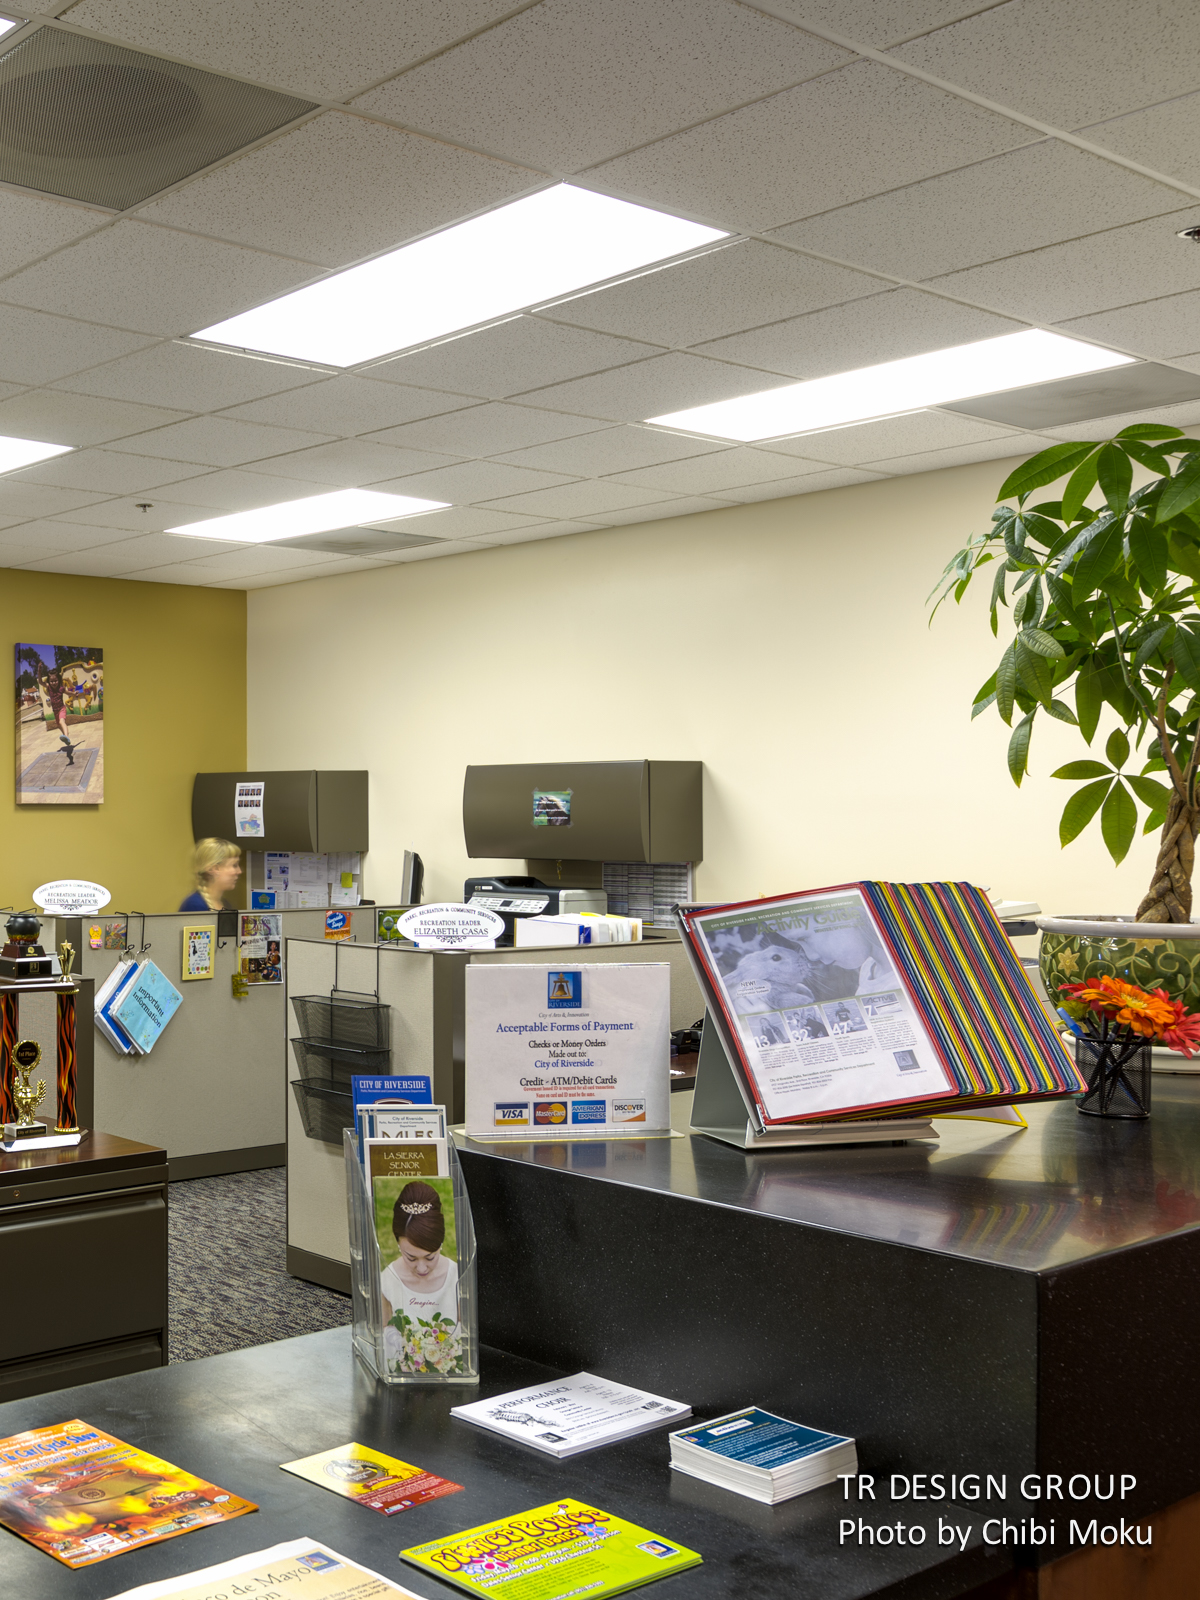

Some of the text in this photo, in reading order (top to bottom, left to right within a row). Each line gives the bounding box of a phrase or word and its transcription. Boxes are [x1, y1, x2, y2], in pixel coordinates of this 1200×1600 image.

[419, 907, 444, 916] RECREATION
[451, 907, 476, 915] COMMUNITY
[477, 911, 496, 923] SERVICES
[757, 908, 860, 935] Activity Guide
[138, 986, 164, 1017] Important
[866, 995, 893, 1004] ACTIVE
[133, 991, 161, 1028] Information
[863, 1005, 873, 1017] 7
[496, 1021, 633, 1035] Acceptable Forms of Payment
[832, 1022, 848, 1035] 47
[754, 1035, 770, 1048] 13
[791, 1028, 808, 1042] 32
[529, 1040, 550, 1048] Checks
[561, 1040, 583, 1050] Money
[585, 1039, 606, 1047] Orders
[549, 1050, 566, 1058] Made
[535, 1059, 594, 1070] City of Riverside
[360, 1080, 426, 1089] CITY OF RIVERSIDE
[520, 1075, 617, 1086] Credit ATM/Debit Cards
[502, 1110, 523, 1119] VISA
[389, 1161, 420, 1169] SENIOR
[499, 1386, 572, 1409] PERFORMANCE
[536, 1397, 571, 1409] CHOIR
[4, 1453, 17, 1462] &
[15, 1436, 70, 1459] Car/Cycle
[66, 1432, 99, 1444] Show
[88, 1443, 116, 1452] GARDENS
[47, 1456, 68, 1465] SHOW
[8, 1478, 34, 1488] 2014
[508, 1509, 610, 1538] Power
[588, 1530, 621, 1545] per person
[494, 1528, 585, 1563] Dinner Dance
[566, 1547, 593, 1561] Chestnut
[471, 1564, 511, 1583] Friday, May
[481, 1563, 545, 1588] Dales Senior Center
[232, 1566, 312, 1595] de Mayo
